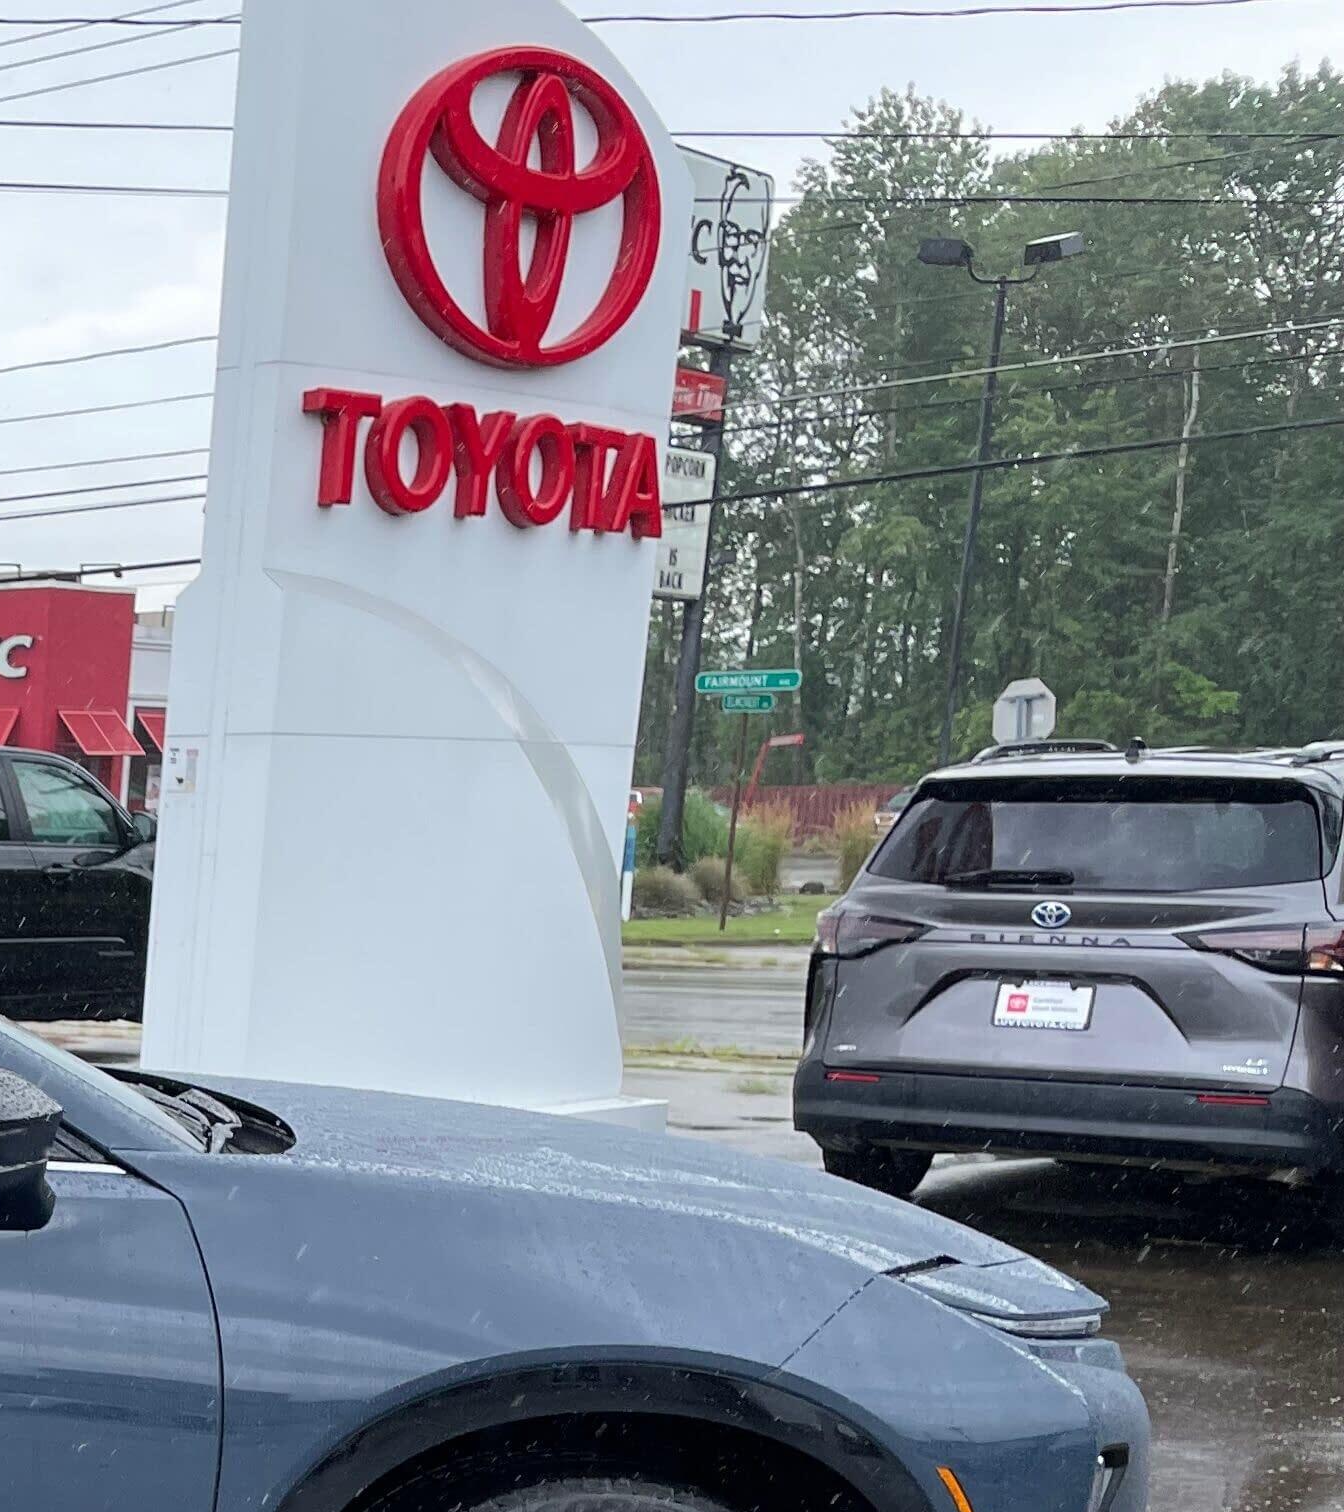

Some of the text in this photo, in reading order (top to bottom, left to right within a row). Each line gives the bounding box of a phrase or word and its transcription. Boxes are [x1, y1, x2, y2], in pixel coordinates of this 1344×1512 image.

[302, 387, 662, 539] TOYOTA
[666, 454, 705, 478] POPCORN
[669, 549, 678, 566] IS
[660, 571, 682, 589] BACK
[704, 675, 768, 688] FAIRMOUNT
[970, 933, 1131, 946] SIENNA
